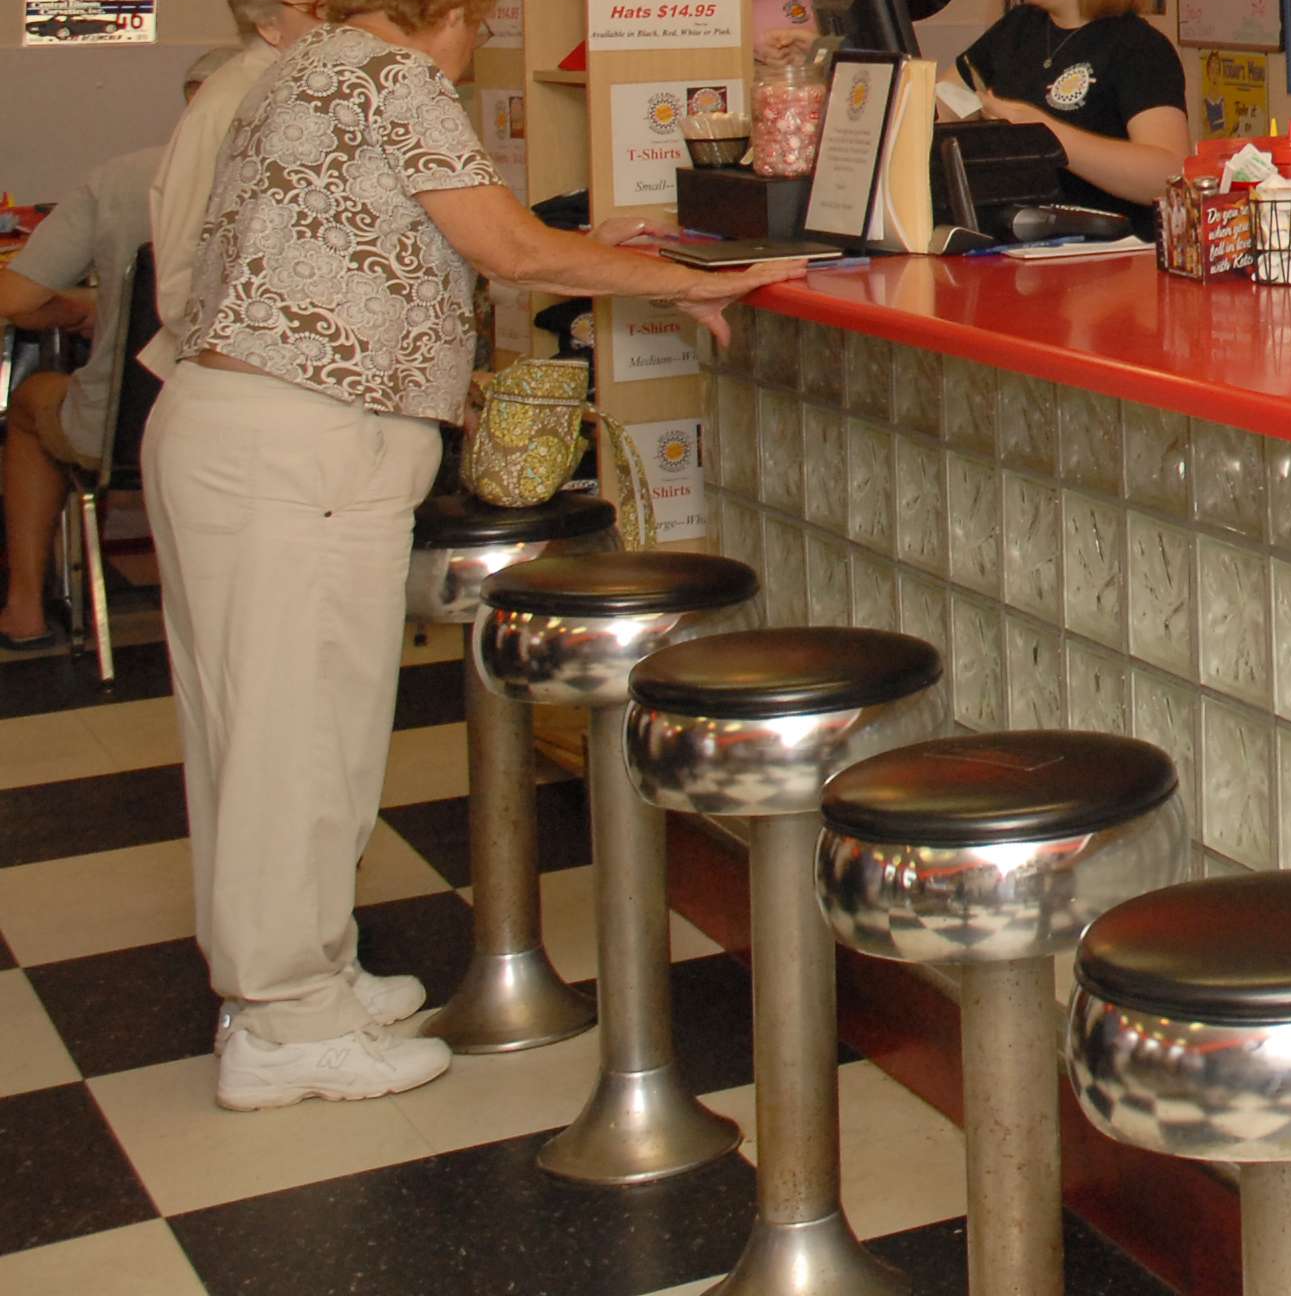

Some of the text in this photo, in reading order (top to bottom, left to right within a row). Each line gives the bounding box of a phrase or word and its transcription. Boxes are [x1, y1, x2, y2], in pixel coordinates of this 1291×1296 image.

[610, 3, 718, 20] Hats $14.95
[626, 30, 636, 38] in
[680, 27, 702, 37] White
[703, 29, 711, 37] or
[626, 147, 682, 162] T-Shirts
[1209, 260, 1232, 275] with
[626, 322, 681, 337] T-Shirts
[652, 485, 691, 499] Shirts
